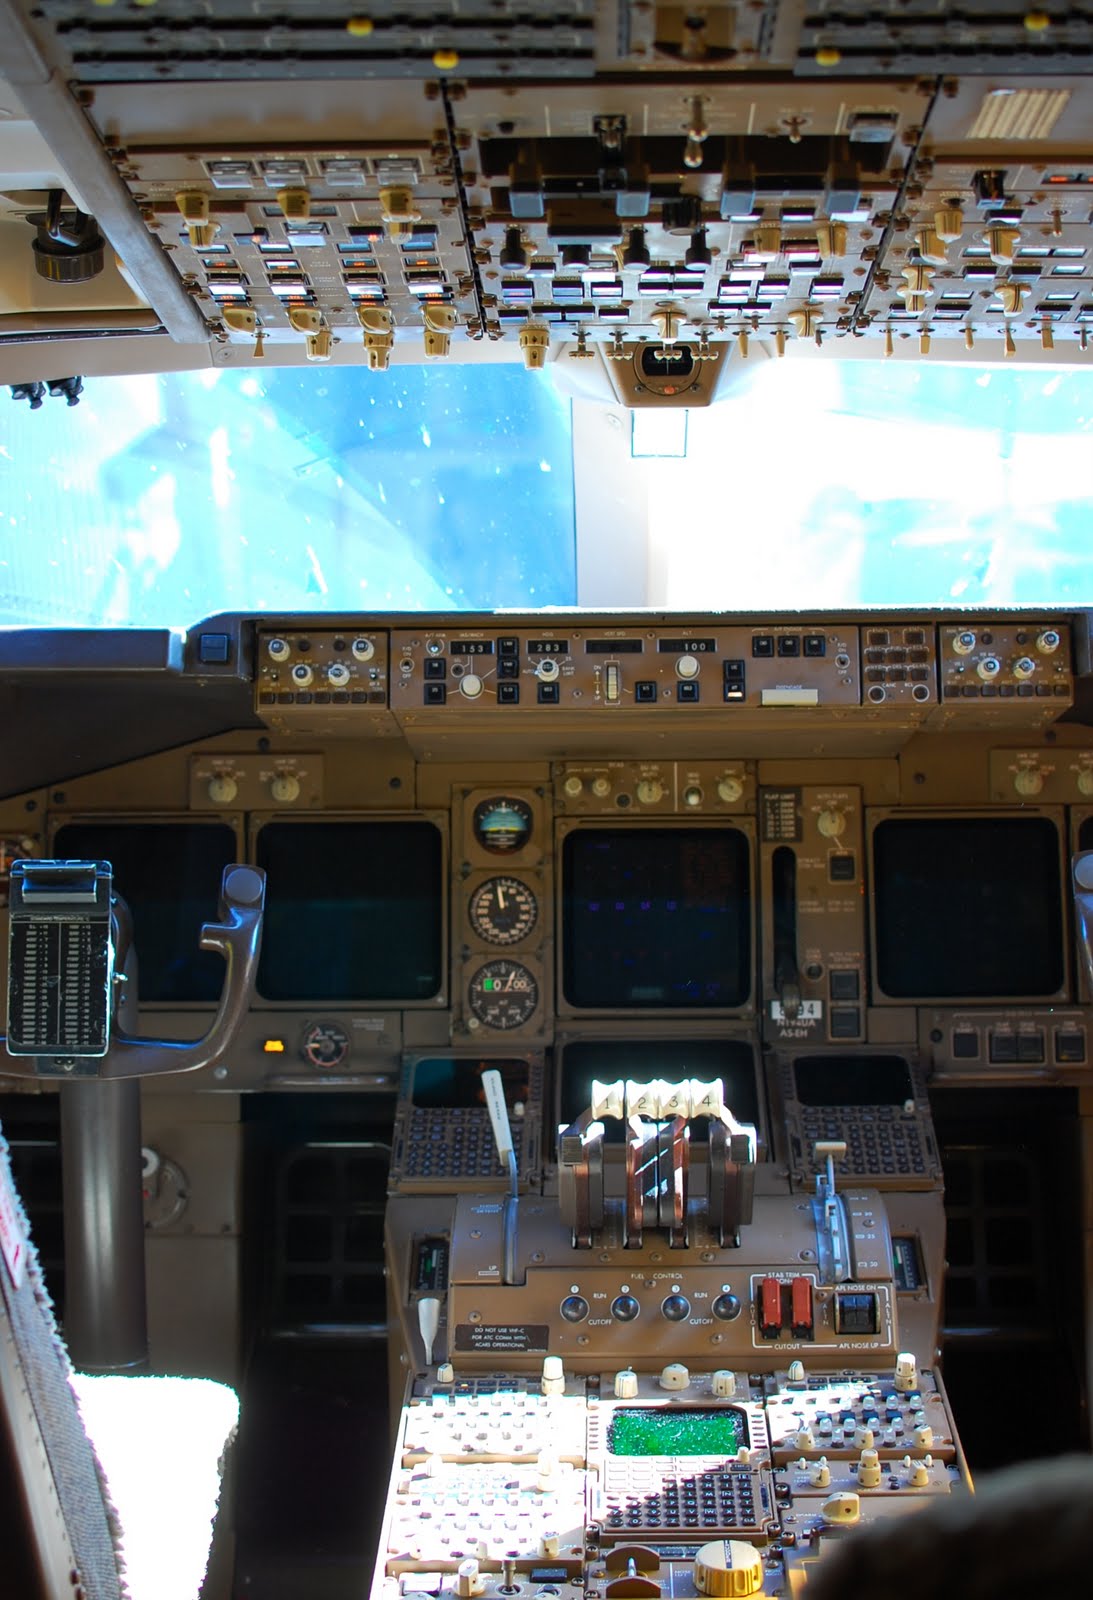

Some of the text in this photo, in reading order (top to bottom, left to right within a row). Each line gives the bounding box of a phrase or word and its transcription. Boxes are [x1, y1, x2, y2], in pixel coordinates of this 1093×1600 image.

[604, 1098, 610, 1109] 1
[638, 1097, 646, 1109] 2
[669, 1096, 678, 1107] 3
[702, 1095, 710, 1106] 4
